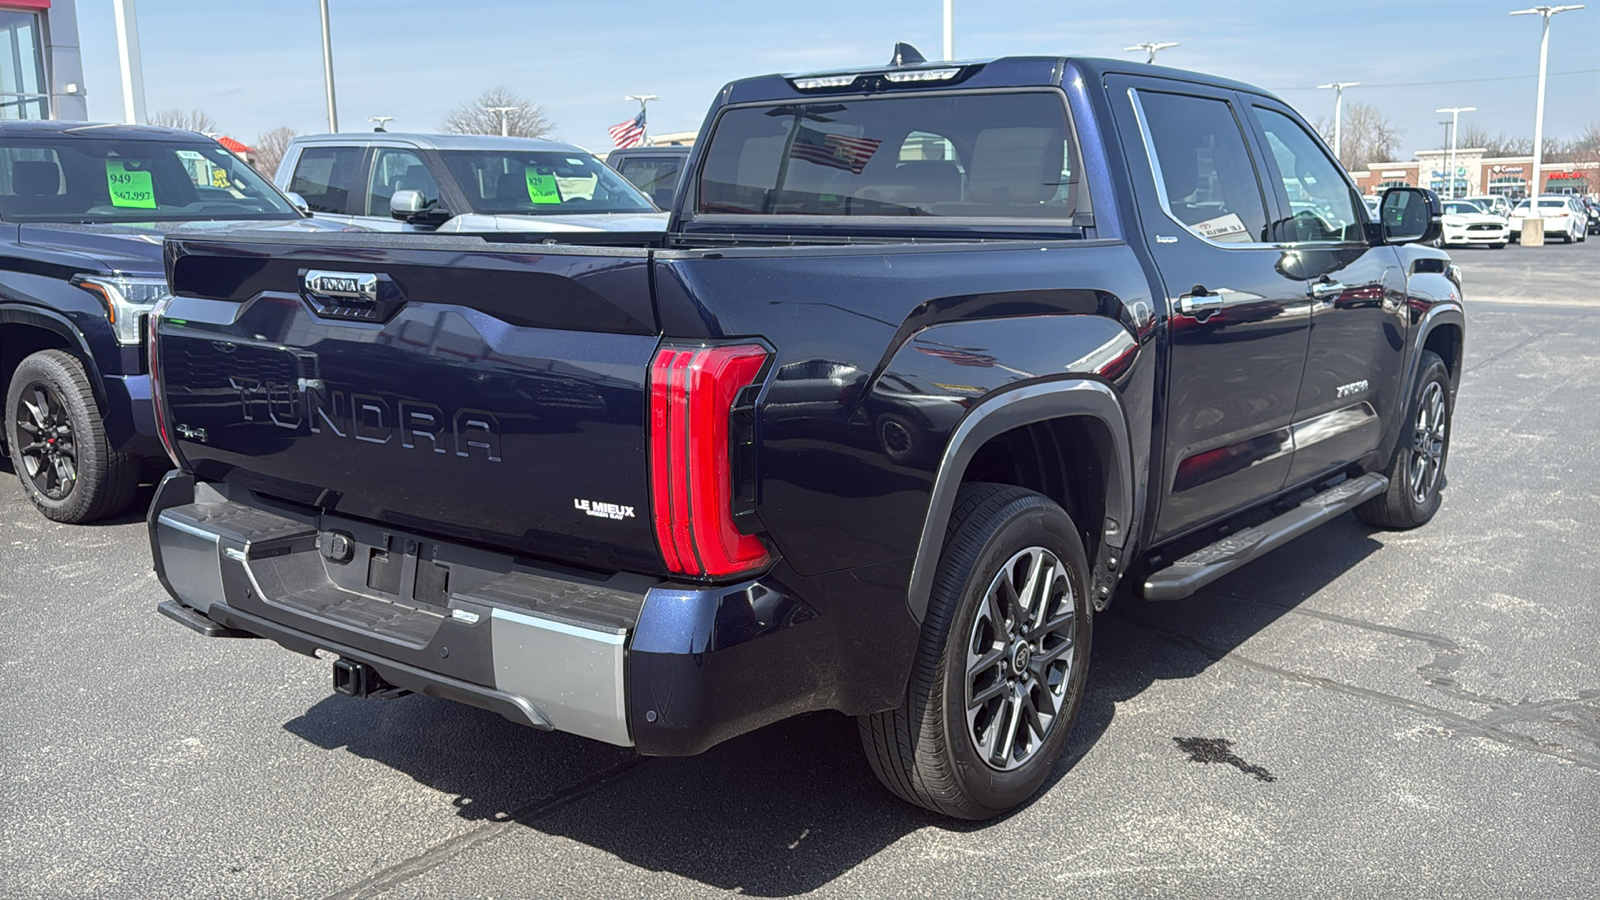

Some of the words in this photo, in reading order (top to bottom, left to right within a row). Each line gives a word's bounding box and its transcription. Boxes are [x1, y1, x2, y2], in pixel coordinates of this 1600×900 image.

[110, 173, 131, 185] 949
[528, 177, 543, 186] 829
[322, 278, 357, 292] TOYOTA
[228, 376, 502, 463] TUNDRA
[574, 498, 591, 511] LE
[592, 501, 635, 518] MIEUX
